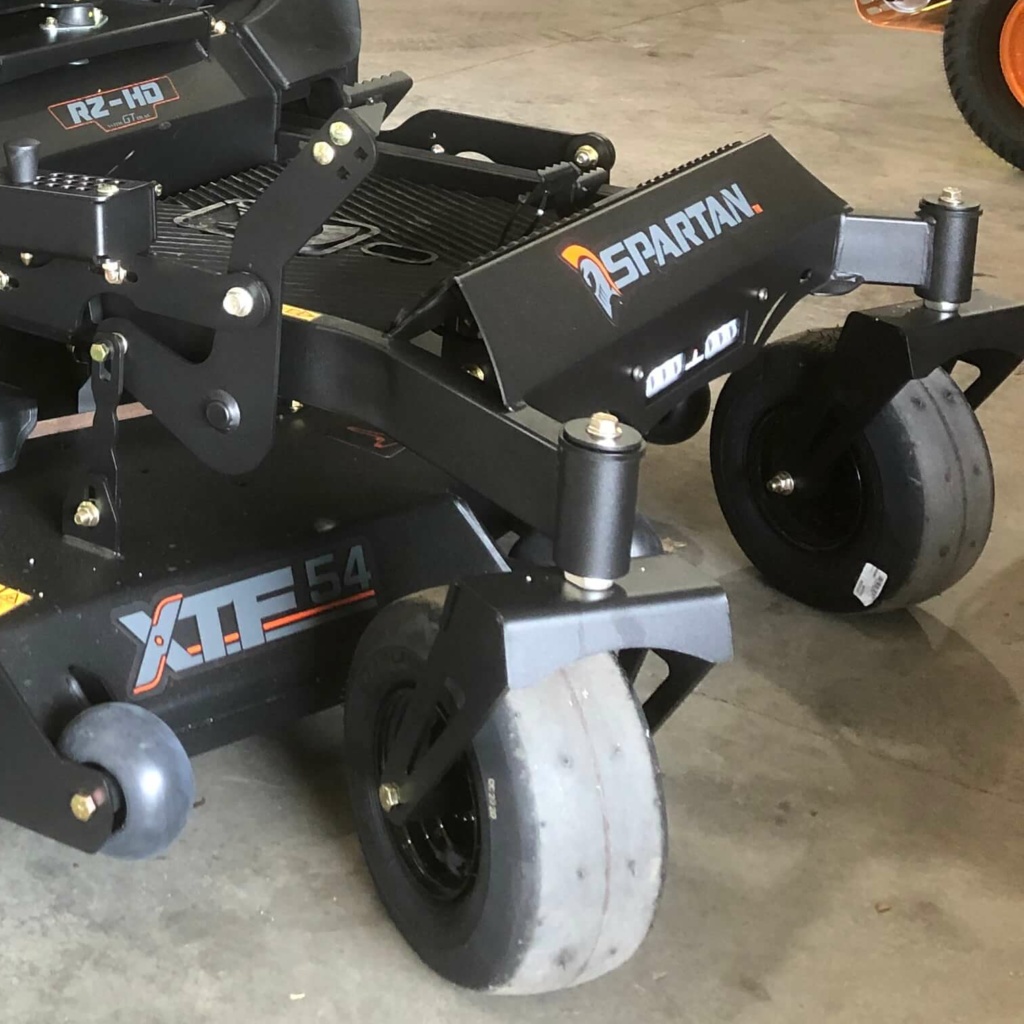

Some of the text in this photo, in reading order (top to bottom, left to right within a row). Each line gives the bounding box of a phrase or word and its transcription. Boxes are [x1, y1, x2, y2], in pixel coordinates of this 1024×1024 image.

[66, 81, 165, 125] RZ-HD
[599, 183, 755, 290] SPARTAN
[118, 544, 372, 695] XTF 54
